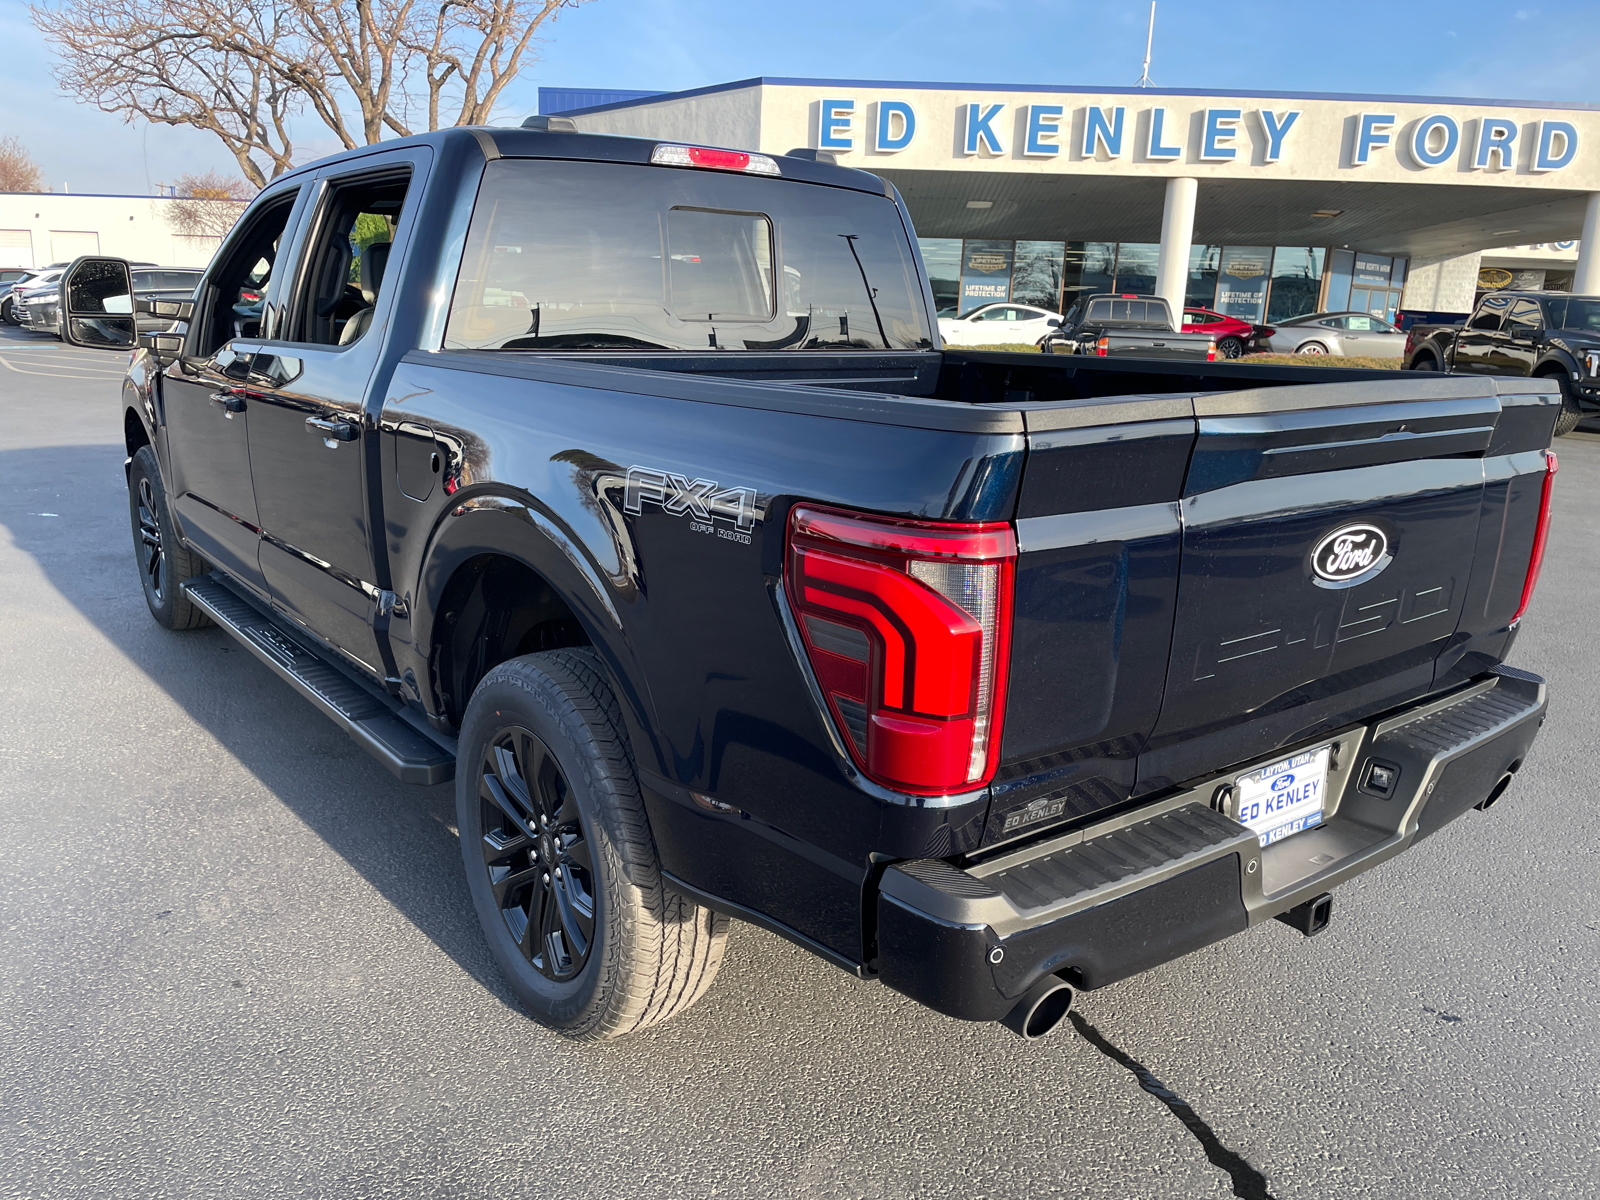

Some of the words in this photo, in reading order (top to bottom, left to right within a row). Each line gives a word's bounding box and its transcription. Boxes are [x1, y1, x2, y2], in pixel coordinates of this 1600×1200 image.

[818, 98, 917, 153] ED
[963, 102, 1304, 163] KENLEY
[1352, 112, 1581, 173] FORD
[623, 465, 757, 533] FX4
[689, 521, 714, 534] OFF
[717, 528, 752, 545] ROAD
[1326, 533, 1377, 573] Ford
[1291, 753, 1310, 768] UTAH
[1274, 774, 1292, 791] Ford
[1240, 802, 1259, 823] ED
[1265, 779, 1320, 815] KENLEY
[1004, 816, 1020, 828] ED
[1022, 802, 1066, 823] KENLEY
[1269, 817, 1306, 843] KENLEY
